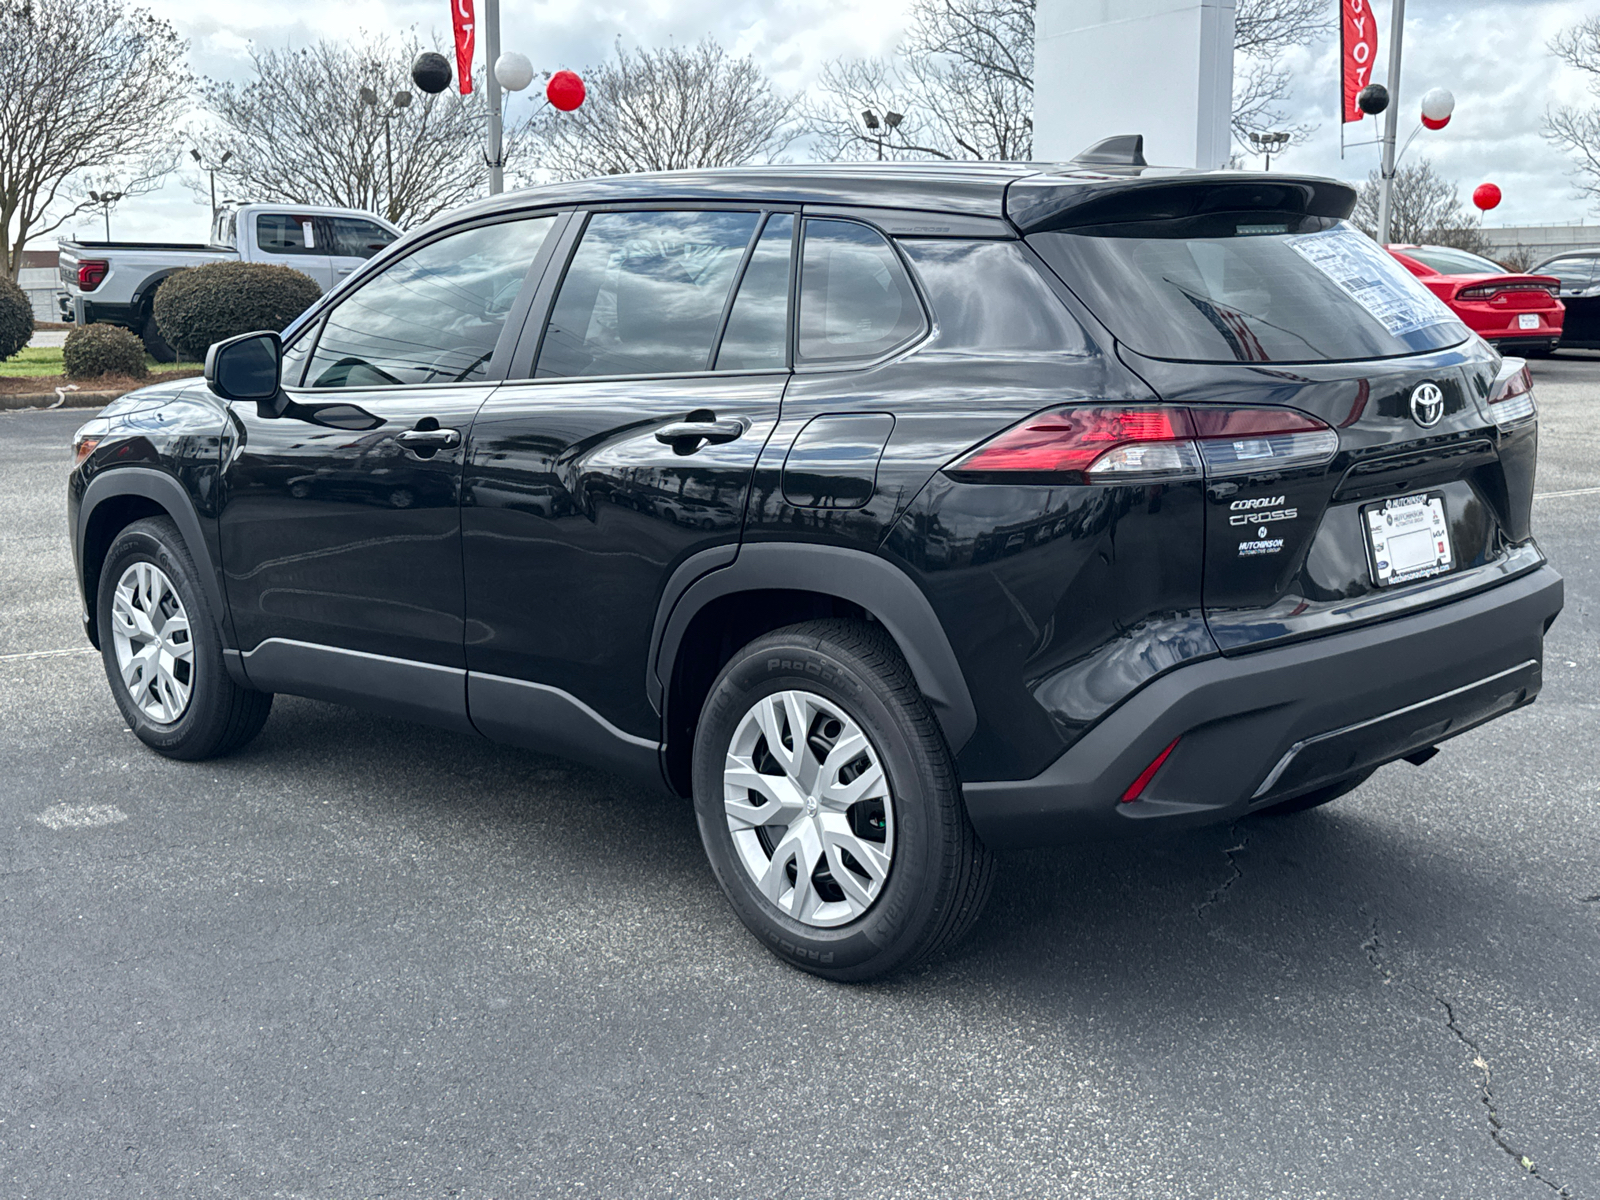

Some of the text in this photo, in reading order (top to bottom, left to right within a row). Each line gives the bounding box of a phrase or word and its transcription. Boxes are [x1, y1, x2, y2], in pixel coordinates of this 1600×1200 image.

[1229, 495, 1285, 511] COROLLA
[1229, 508, 1297, 526] CROSS
[1238, 539, 1284, 551] HUTCHINSON
